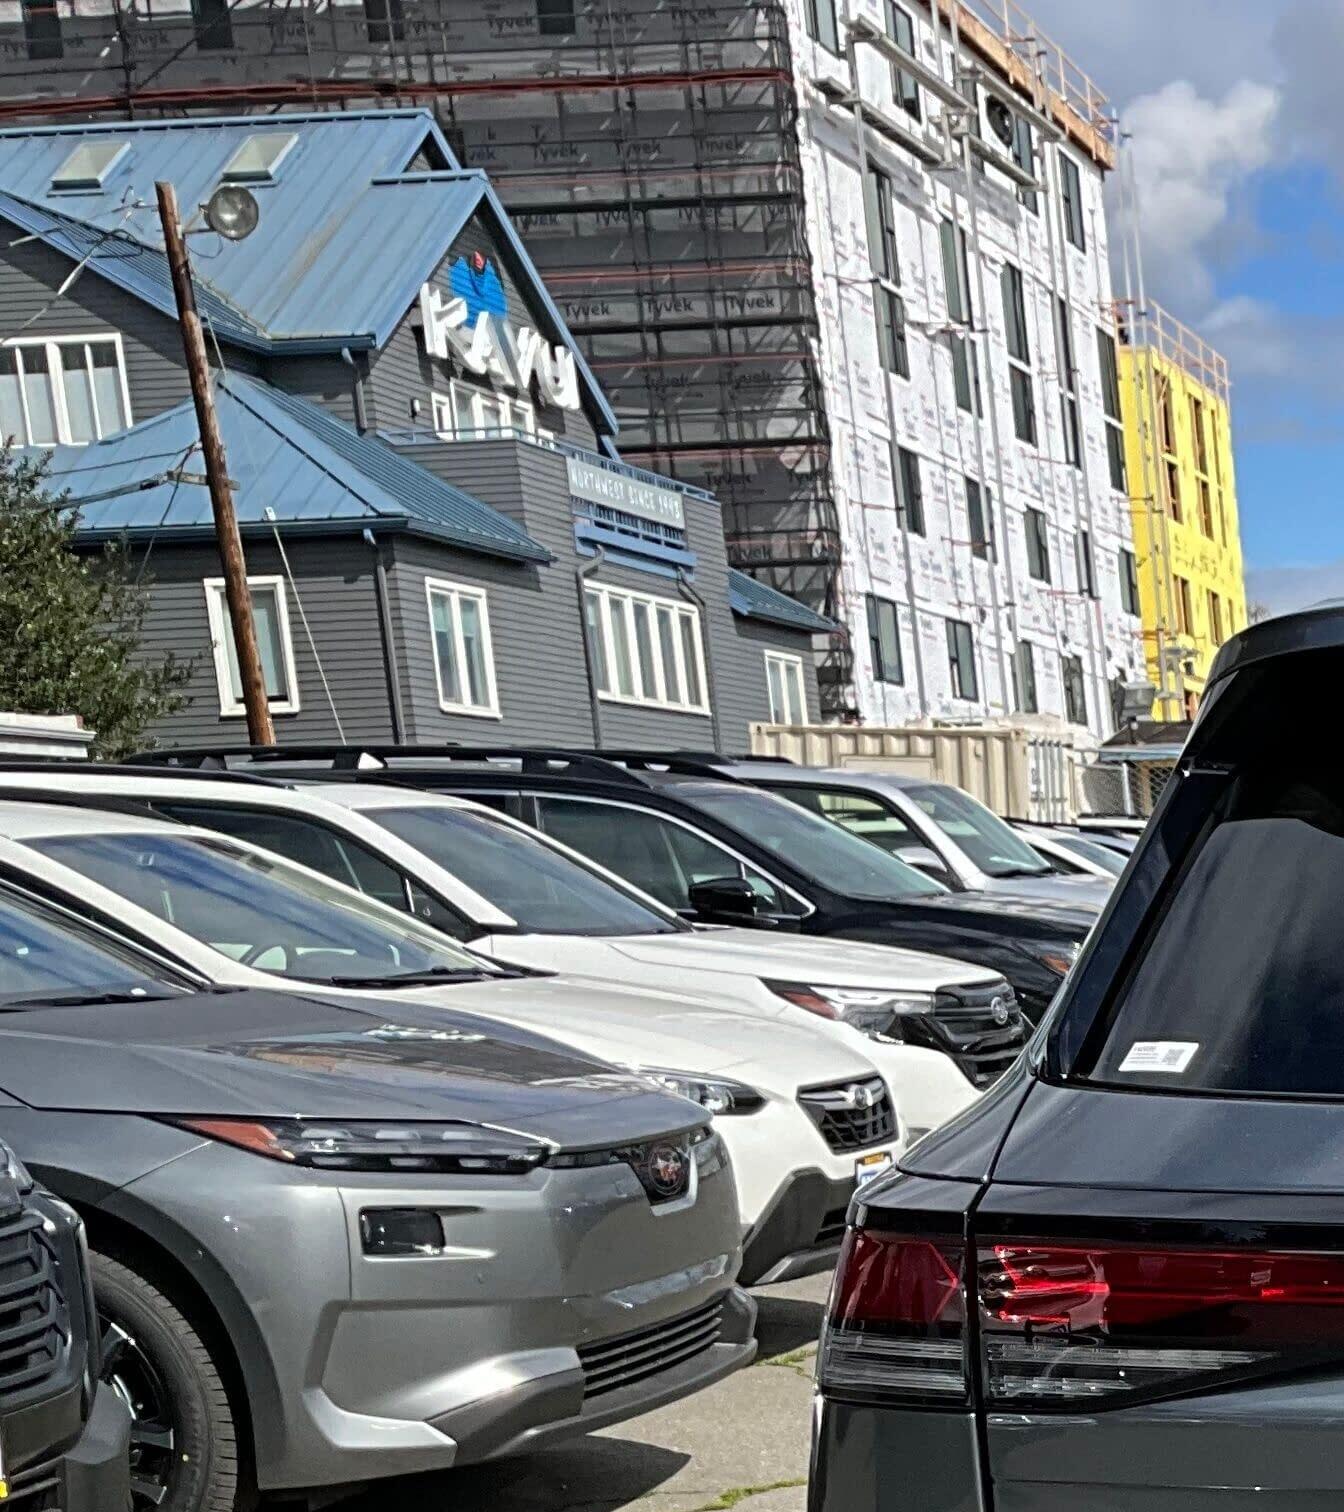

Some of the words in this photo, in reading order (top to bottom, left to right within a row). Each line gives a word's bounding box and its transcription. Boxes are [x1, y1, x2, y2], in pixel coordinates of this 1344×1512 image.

[563, 302, 612, 320] Tyvek
[648, 298, 695, 317] Tyvek
[420, 282, 581, 410] KAVU
